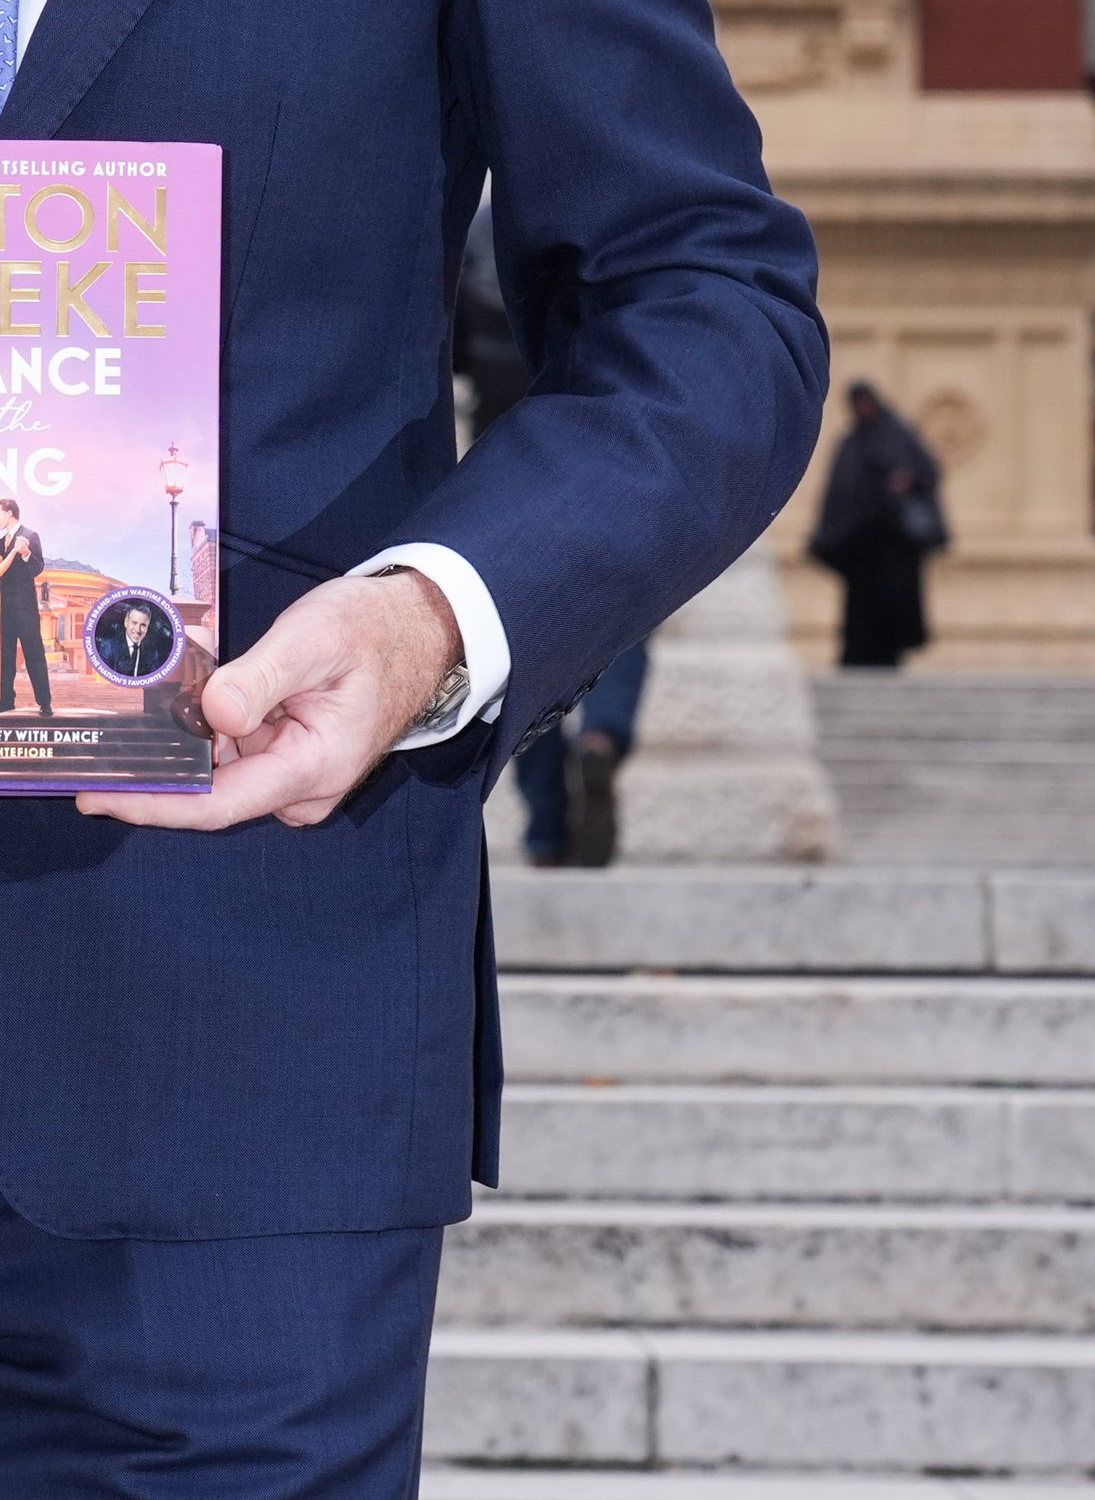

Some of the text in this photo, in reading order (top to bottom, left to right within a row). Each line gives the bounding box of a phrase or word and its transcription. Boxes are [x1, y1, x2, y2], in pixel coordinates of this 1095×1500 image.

[93, 161, 167, 177] AUTHOR
[86, 589, 182, 633] THE BRAND-NEW WARTIME ROMANCE
[84, 636, 95, 656] FROM
[90, 656, 99, 667] THE
[128, 673, 163, 686] FAVOURITE
[162, 637, 184, 676] ENTERTAINER
[15, 730, 48, 742] WITH
